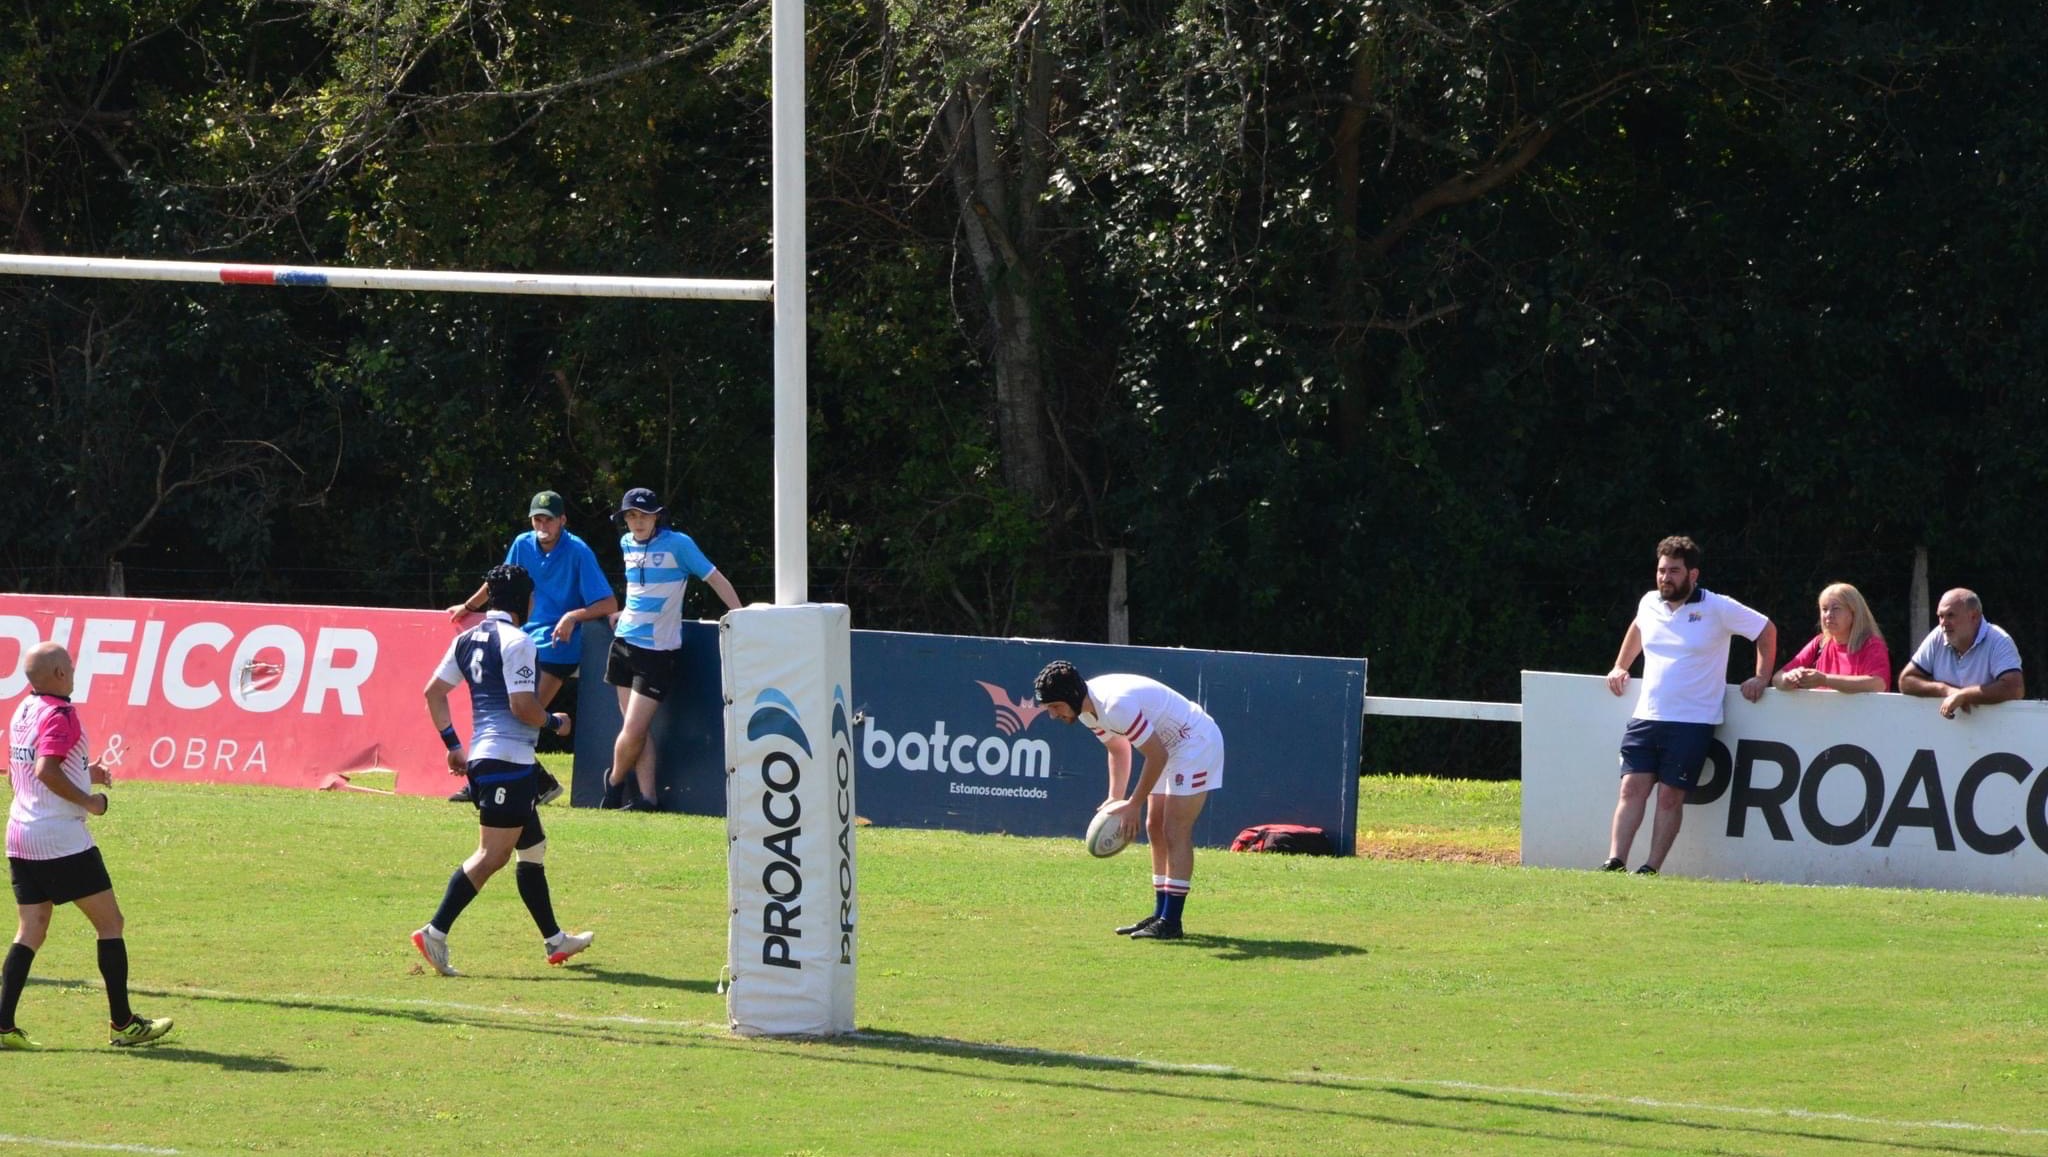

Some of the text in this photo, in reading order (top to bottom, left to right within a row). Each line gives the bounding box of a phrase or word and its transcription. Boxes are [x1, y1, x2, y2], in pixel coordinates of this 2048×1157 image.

[102, 734, 268, 773] & OBRA
[863, 716, 1050, 778] batcom
[494, 787, 506, 805] 6
[950, 782, 1048, 799] Estamos conectados
[1683, 737, 2048, 857] ROAC
[761, 751, 802, 970] PROACO
[836, 748, 854, 965] PROACO
